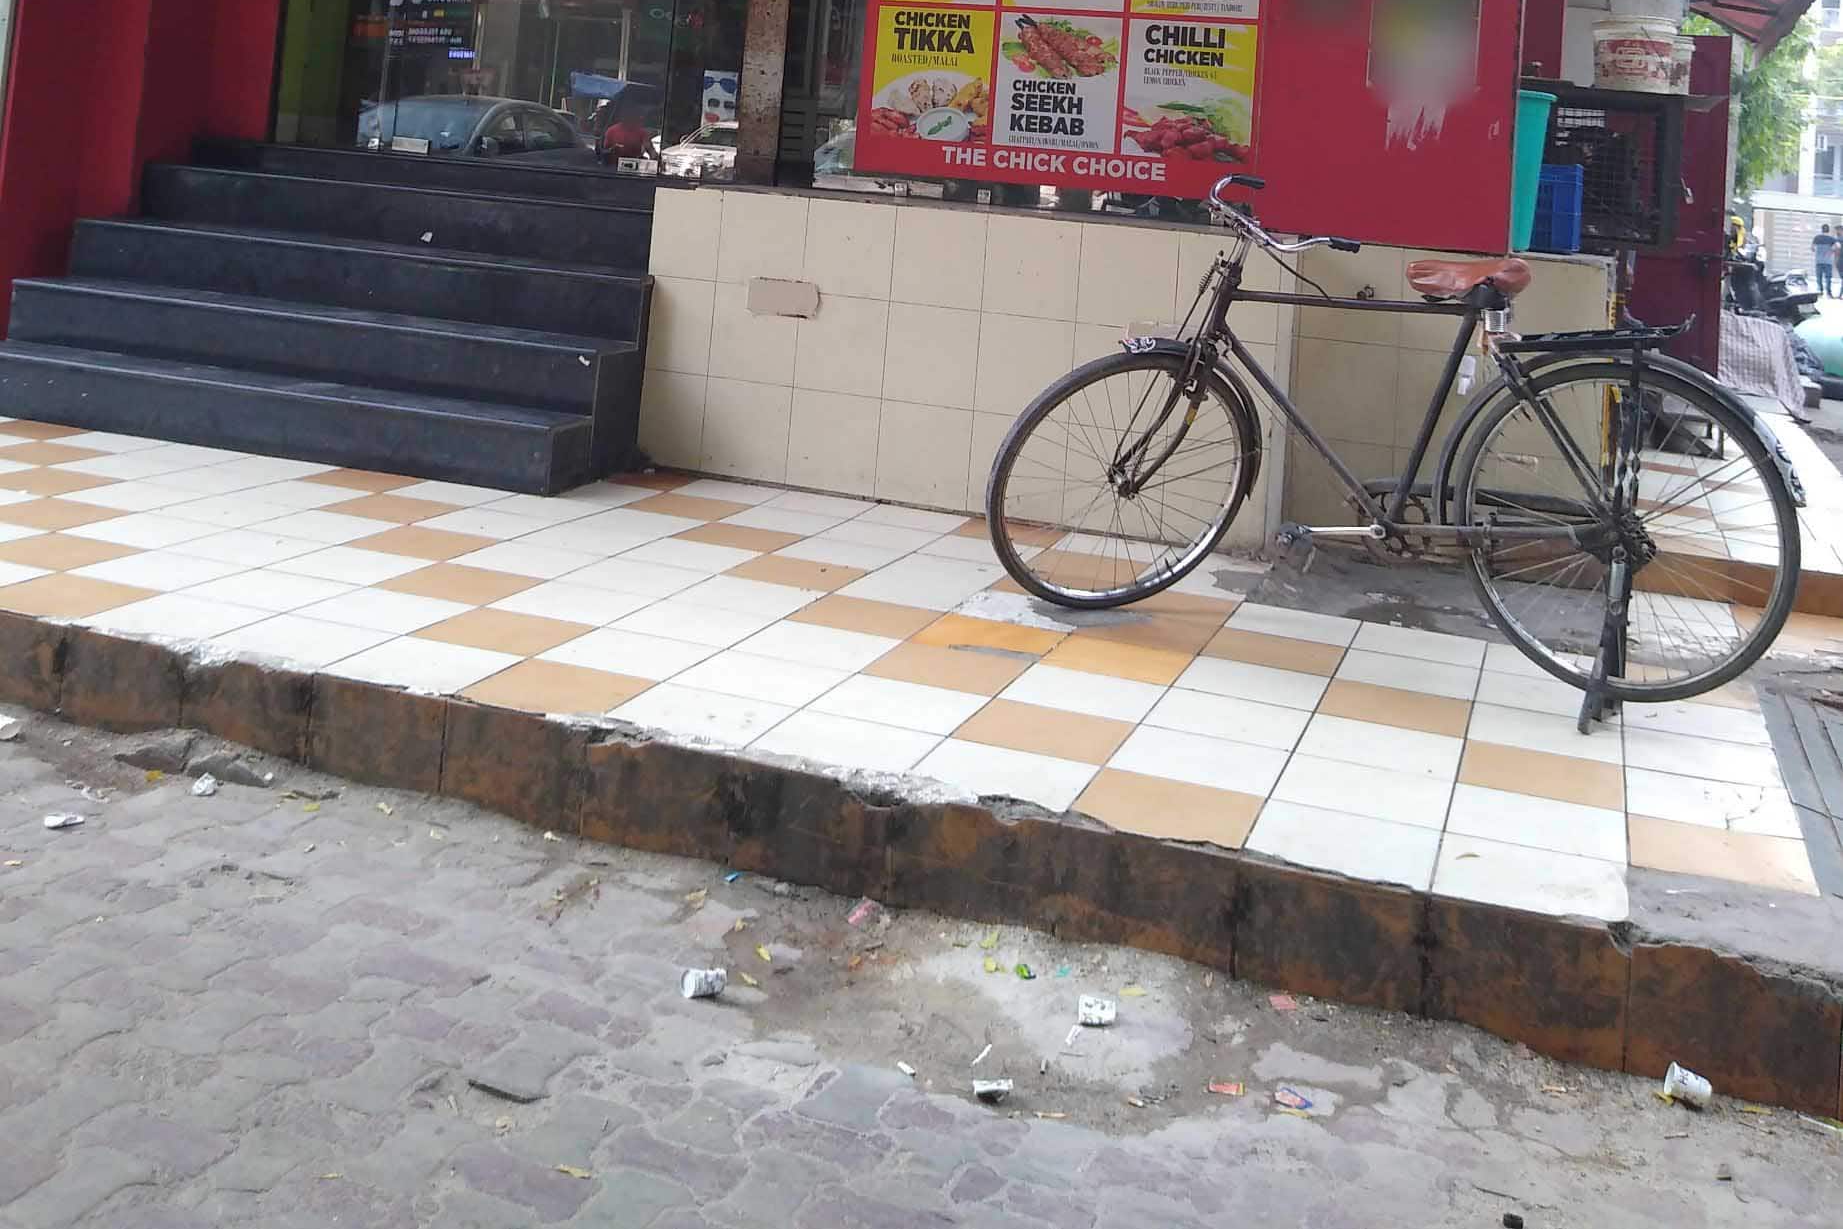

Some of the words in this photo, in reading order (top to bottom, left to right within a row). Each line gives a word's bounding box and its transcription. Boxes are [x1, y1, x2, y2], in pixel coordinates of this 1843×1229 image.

[894, 11, 971, 29] CHICKEN
[894, 27, 975, 54] TIKKA
[1145, 24, 1226, 49] CHILLI
[1143, 48, 1224, 67] CHICKEN
[1012, 79, 1076, 95] CHICKEN
[1010, 92, 1083, 115] SEEKH
[1009, 113, 1084, 136] KEBAB
[942, 146, 987, 167] THE
[993, 151, 1067, 174] CHICK
[1072, 156, 1167, 182] CHOICE
